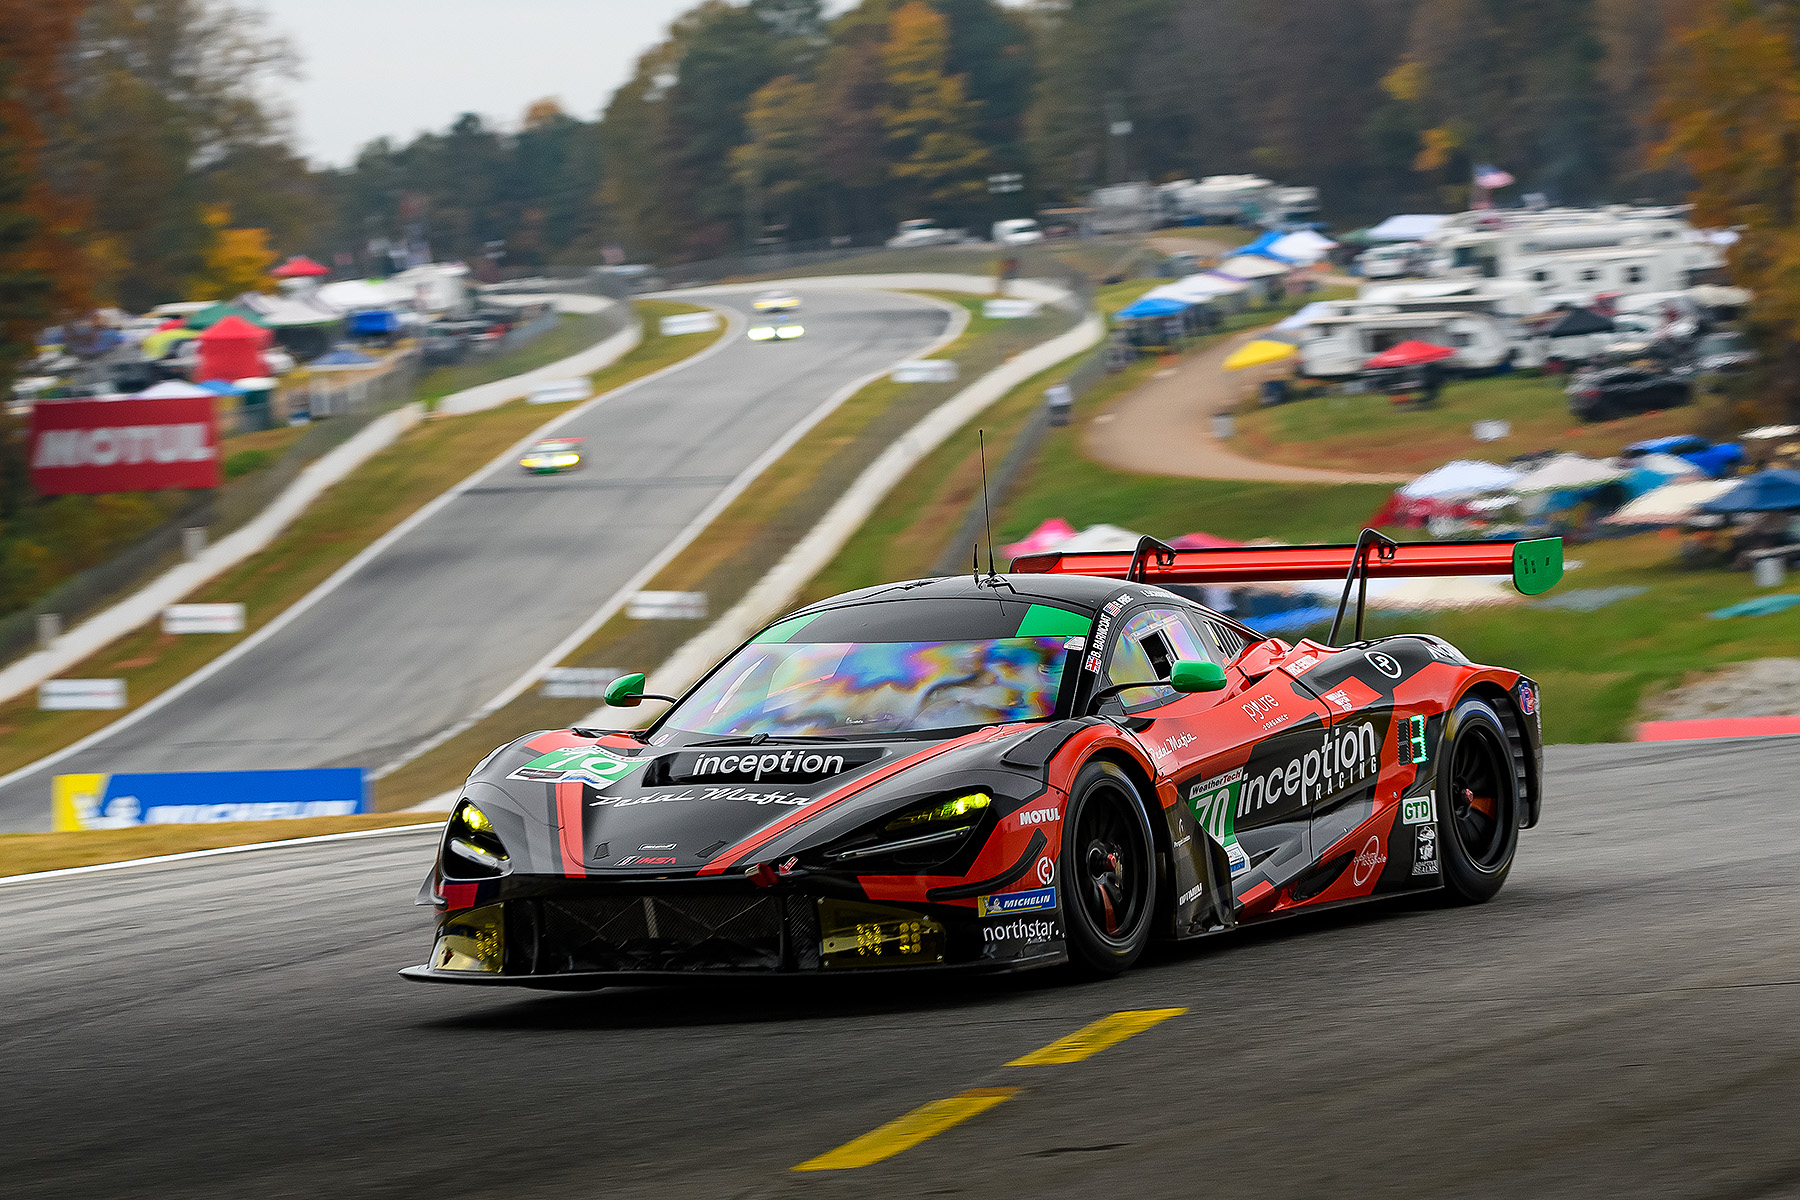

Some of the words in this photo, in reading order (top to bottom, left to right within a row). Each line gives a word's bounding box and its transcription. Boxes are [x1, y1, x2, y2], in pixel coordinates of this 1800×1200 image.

[34, 423, 215, 468] MOTUL
[1241, 694, 1279, 723] pyure
[545, 750, 628, 775] 70
[692, 751, 844, 782] inception
[1237, 721, 1376, 819] inception
[1192, 770, 1242, 796] WeatherTech
[1315, 756, 1377, 801] RACING
[700, 787, 817, 807] Mafia
[1020, 807, 1060, 825] MOTUL
[1195, 788, 1230, 846] 70
[1404, 801, 1429, 820] GTD
[634, 857, 677, 865] IMSA
[1003, 894, 1051, 909] MICHELIN
